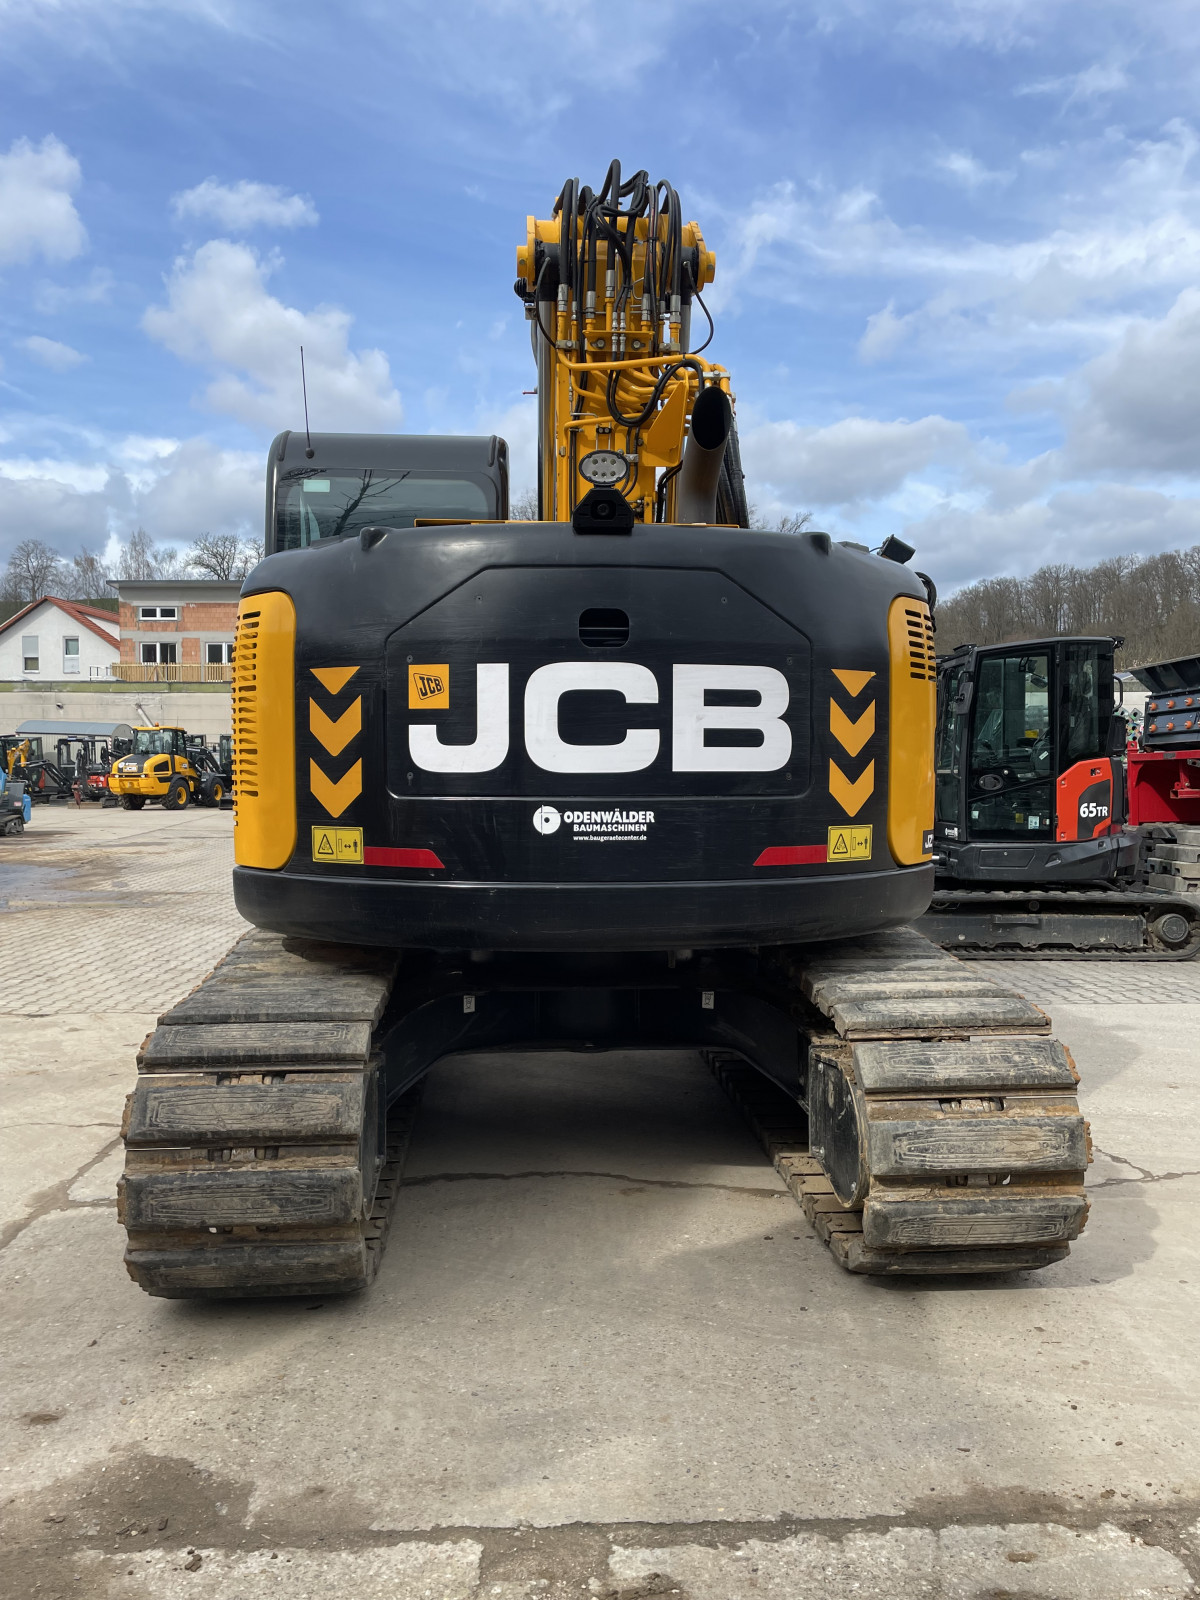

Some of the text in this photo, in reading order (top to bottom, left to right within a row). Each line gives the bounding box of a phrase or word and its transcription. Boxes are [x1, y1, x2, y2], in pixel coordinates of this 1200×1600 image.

[419, 676, 442, 697] JCB
[408, 661, 793, 774] JCB
[563, 808, 655, 823] ODENWÄLDER
[1079, 802, 1108, 818] 65TR
[573, 824, 647, 832] BAUMASCHINEN
[573, 834, 647, 842] www.baugeraetecenter.de
